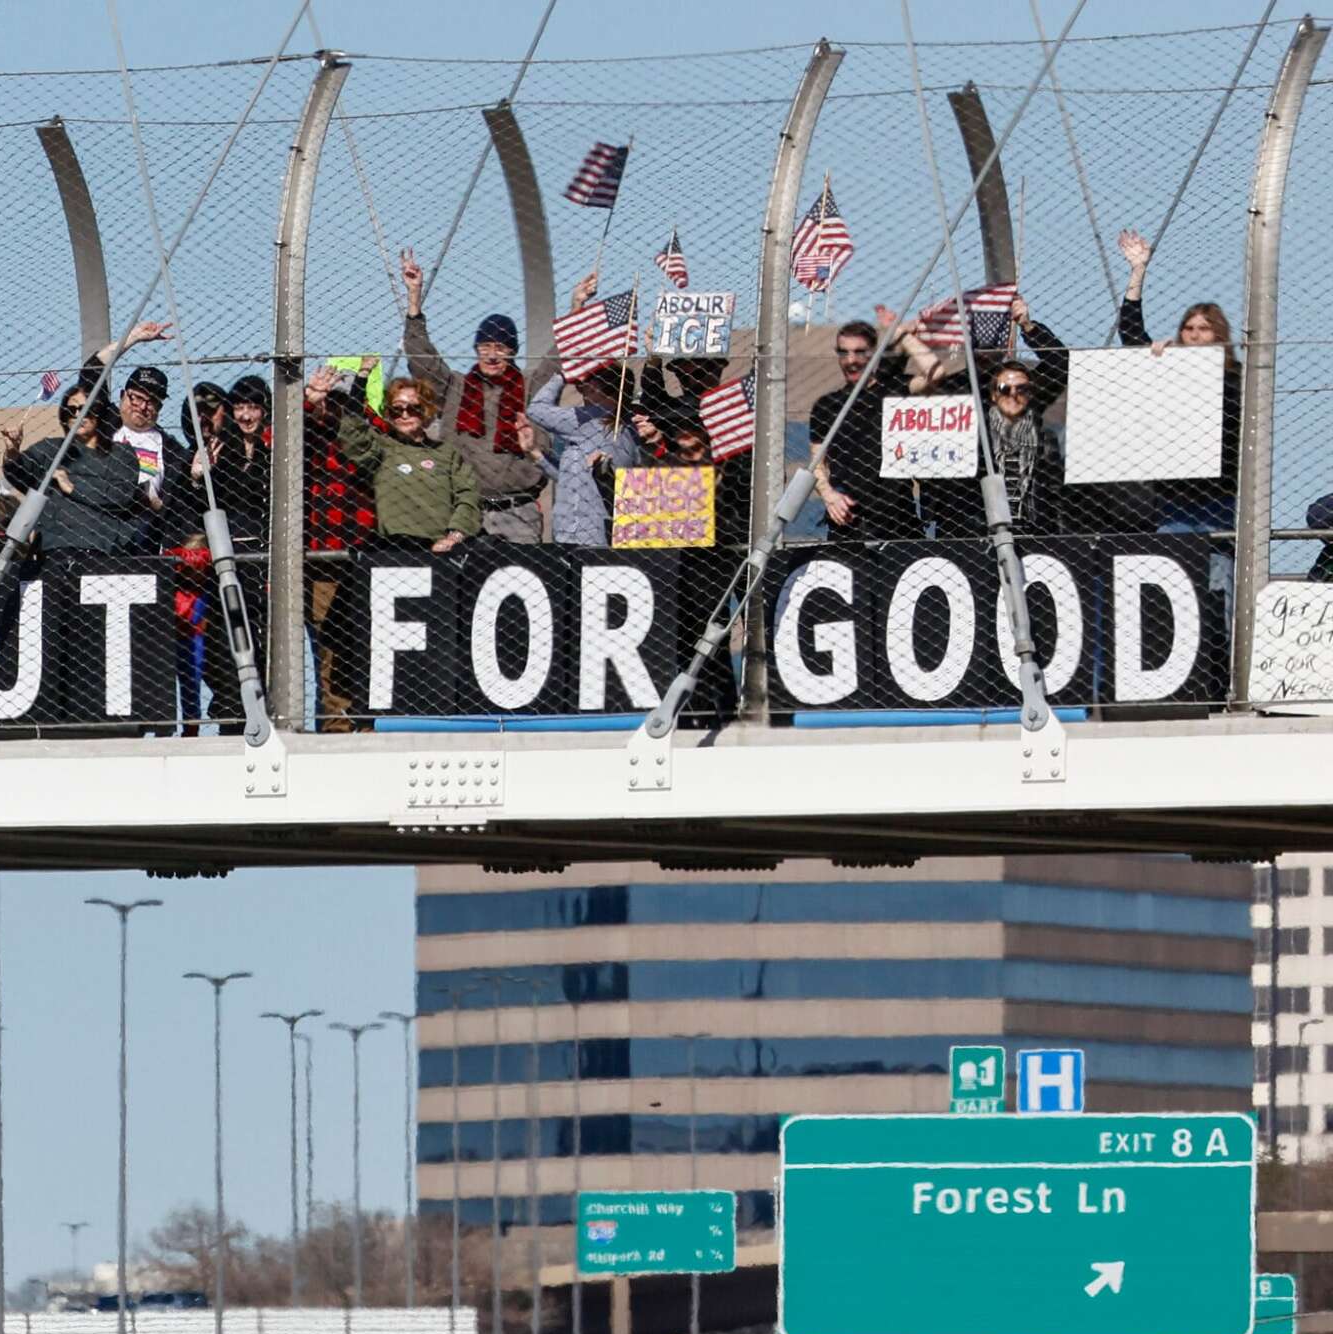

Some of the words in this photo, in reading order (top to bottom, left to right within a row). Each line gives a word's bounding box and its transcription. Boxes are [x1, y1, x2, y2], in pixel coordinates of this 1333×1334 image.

[655, 316, 725, 354] ICE
[888, 402, 973, 433] ABOLISH
[368, 565, 661, 710] FOR
[774, 554, 1201, 704] GOOD
[955, 1100, 998, 1114] DART
[1026, 1054, 1074, 1111] H
[1099, 1132, 1155, 1154] EXIT
[1171, 1129, 1193, 1157] 8
[1205, 1128, 1229, 1157] A
[655, 1203, 684, 1217] Way
[913, 1182, 1052, 1214] Forest
[1077, 1182, 1127, 1213] Ln
